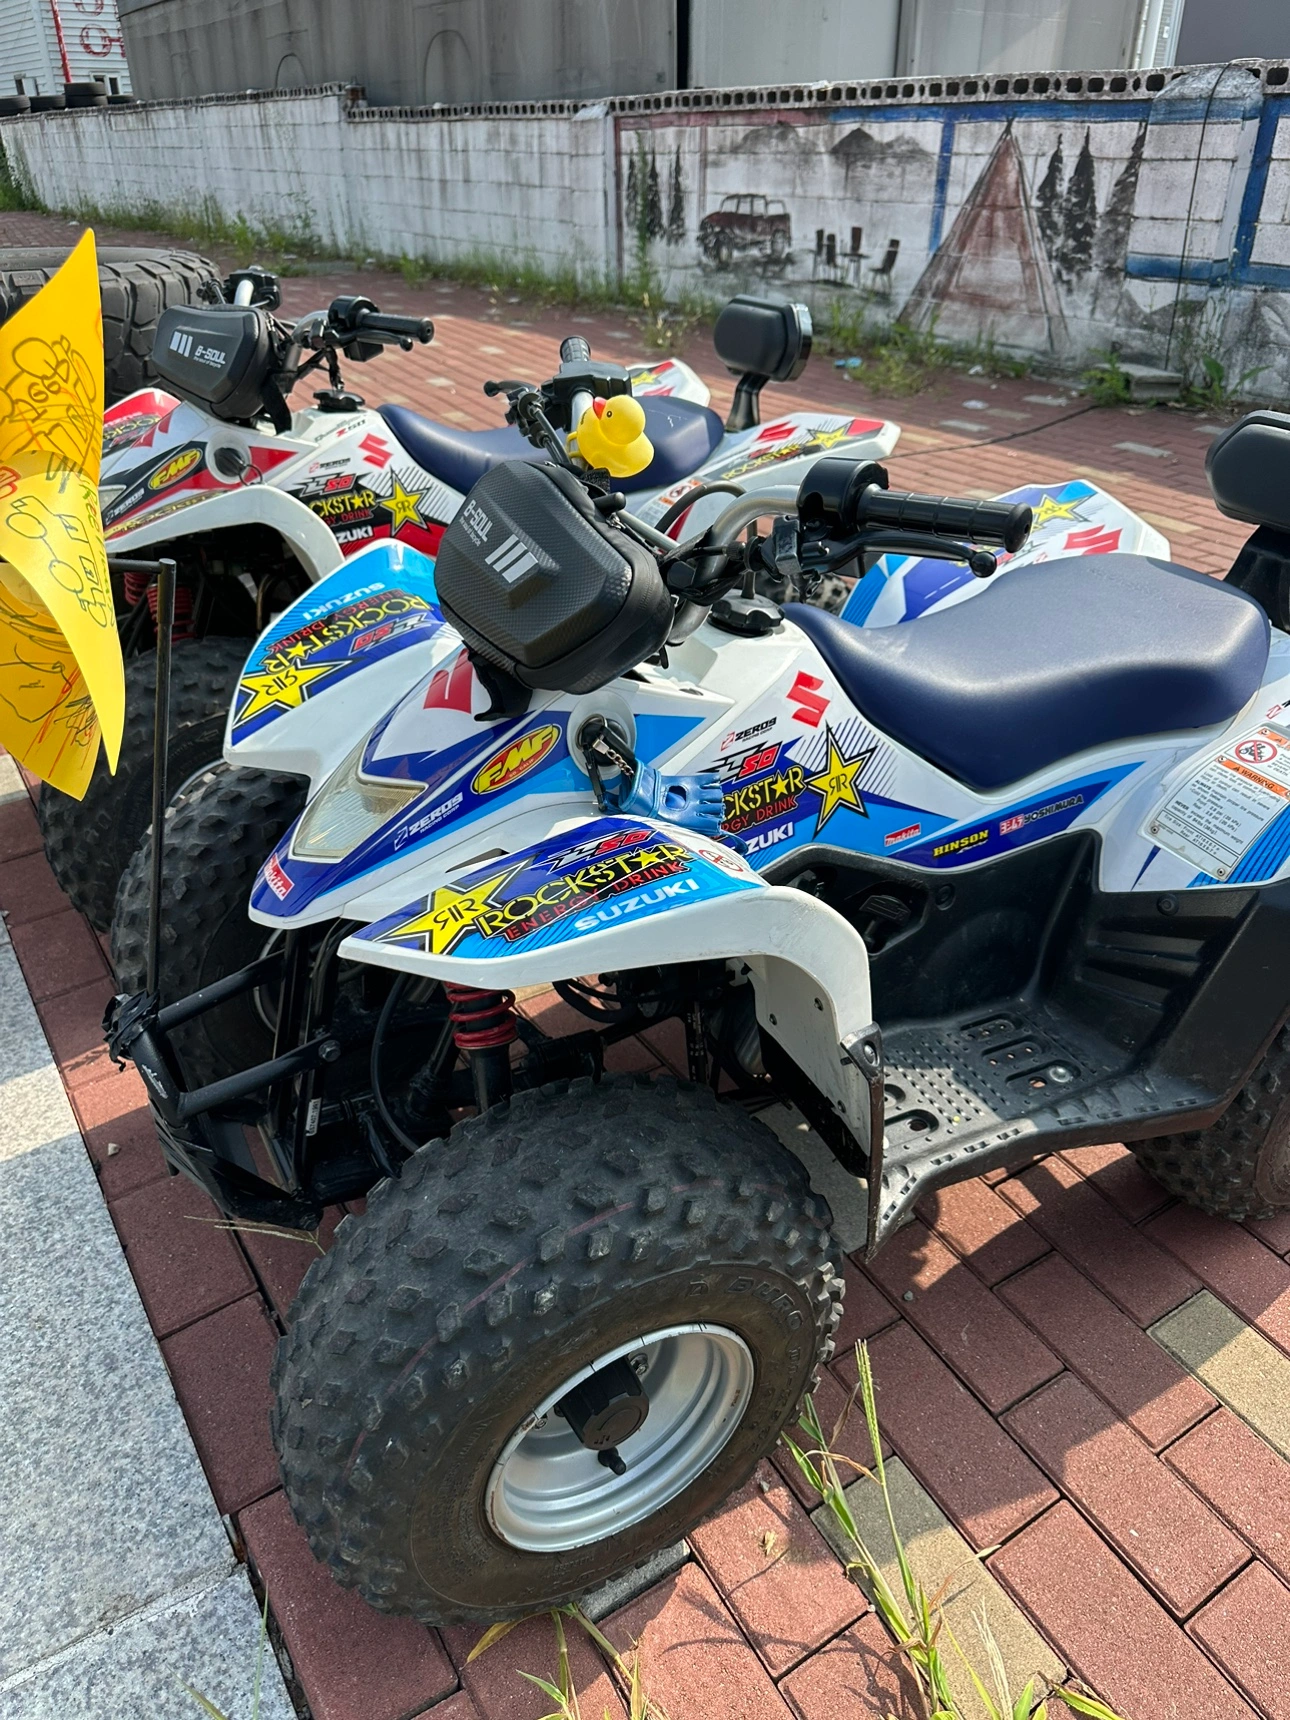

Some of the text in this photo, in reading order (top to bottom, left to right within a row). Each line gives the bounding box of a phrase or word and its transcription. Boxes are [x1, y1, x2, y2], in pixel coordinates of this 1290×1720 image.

[194, 345, 226, 365] B-SOUL
[149, 449, 200, 490] FMF
[309, 489, 377, 518] CKSTAR
[336, 525, 374, 544] ZUKI
[463, 499, 493, 543] B-SOUL
[302, 582, 386, 621] SUZUKI
[735, 716, 777, 742] ZERO9
[477, 723, 554, 795] FMF
[722, 765, 804, 820] CKSTAR
[1194, 778, 1212, 790] ALWAYS
[1239, 767, 1275, 792] WARNING
[408, 791, 463, 836] ZERO9
[756, 795, 796, 821] DRINK
[1023, 794, 1084, 825] YOSHIMURA
[745, 821, 795, 855] ZUKI
[932, 829, 990, 858] HINSON
[506, 861, 684, 941] ENERGY DRINK
[573, 878, 701, 932] SUZUKI
